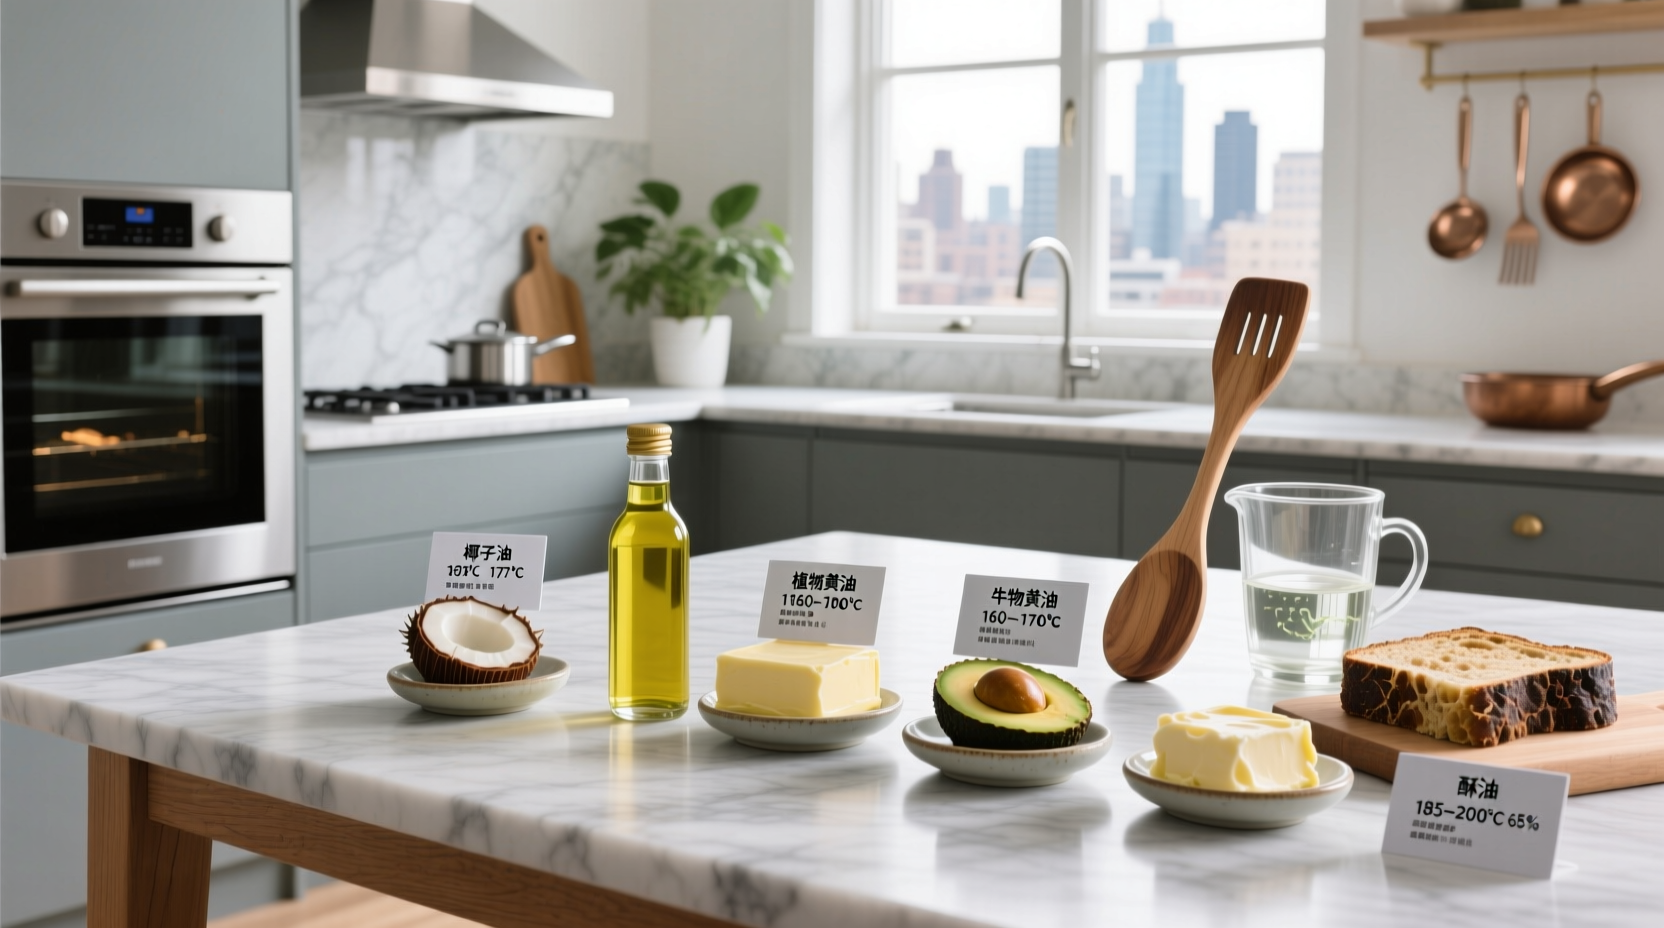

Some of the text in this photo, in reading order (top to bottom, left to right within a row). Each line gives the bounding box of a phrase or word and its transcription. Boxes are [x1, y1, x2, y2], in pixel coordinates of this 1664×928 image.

[463, 542, 512, 562] 椰子油
[1457, 775, 1499, 800] 酥油
